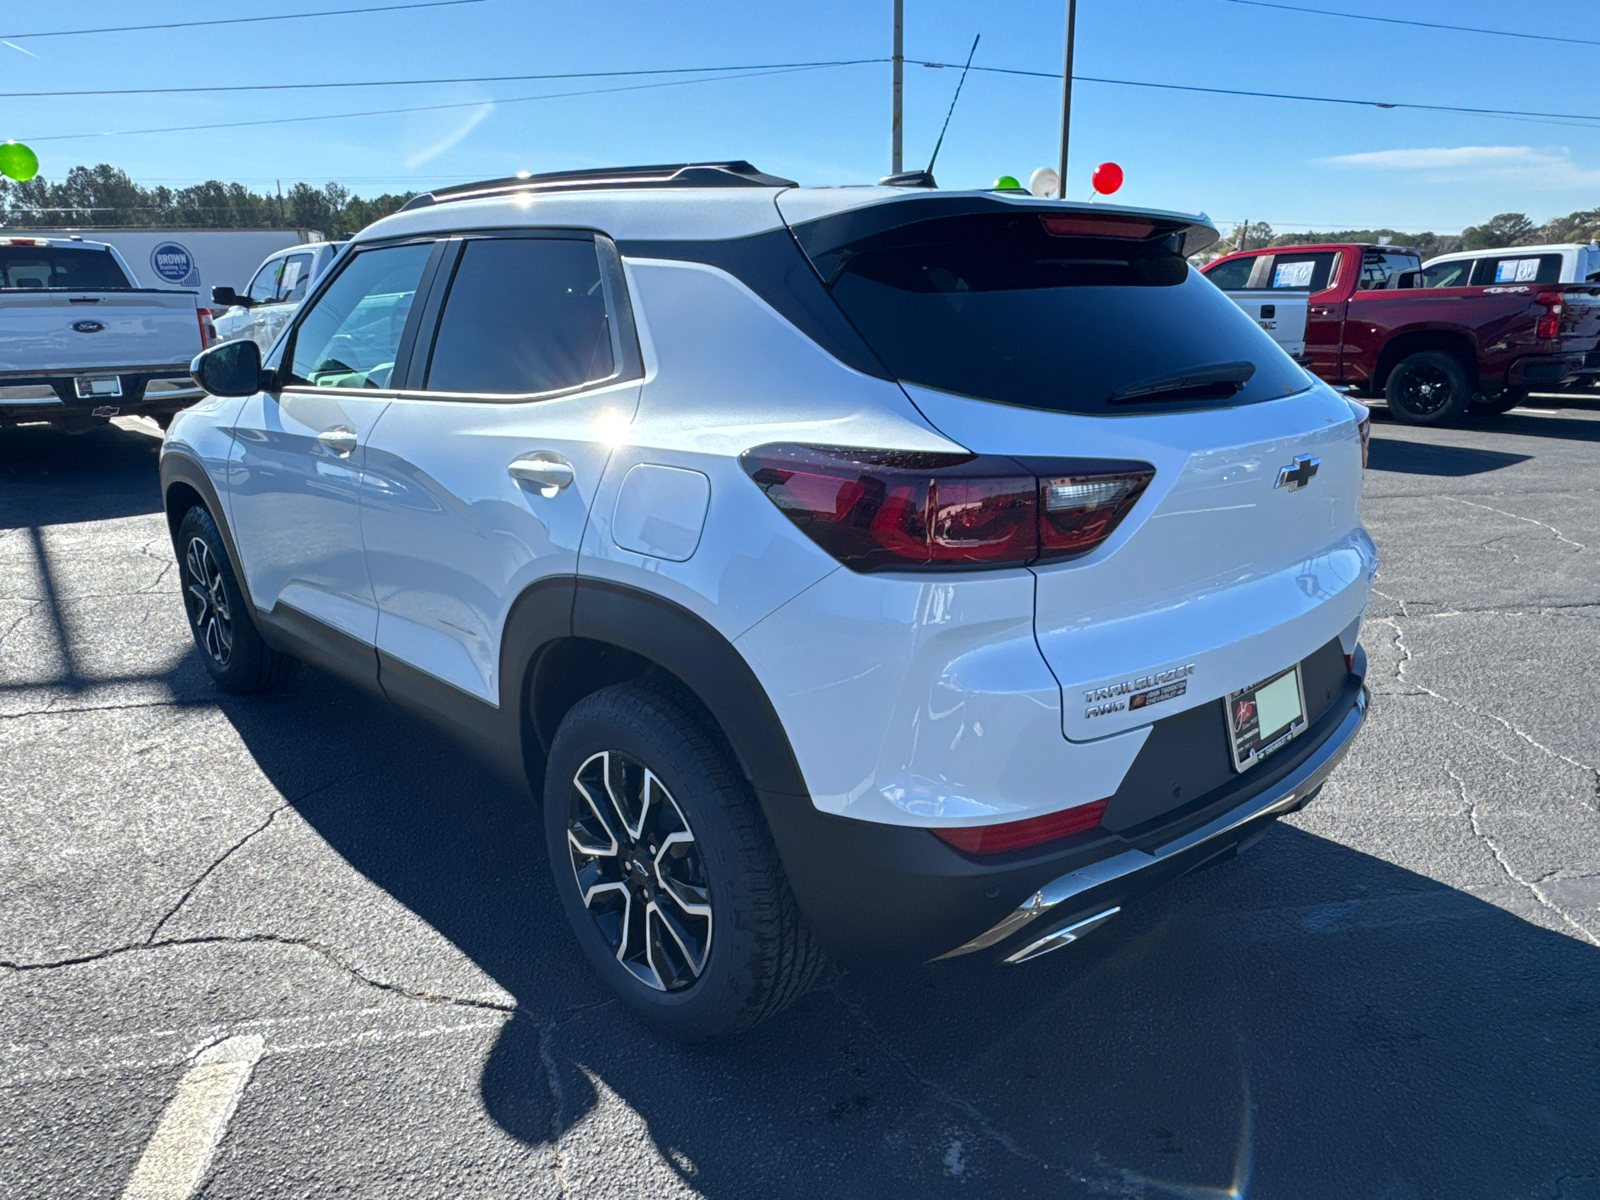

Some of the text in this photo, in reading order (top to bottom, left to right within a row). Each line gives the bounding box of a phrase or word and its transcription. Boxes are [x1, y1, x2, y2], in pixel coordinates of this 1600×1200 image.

[157, 254, 187, 265] BROWN
[1081, 663, 1196, 703] TRAILBLAZER
[1146, 690, 1177, 705] CHEVROLET
[1147, 689, 1161, 699] JOHN
[1085, 699, 1125, 719] AWD
